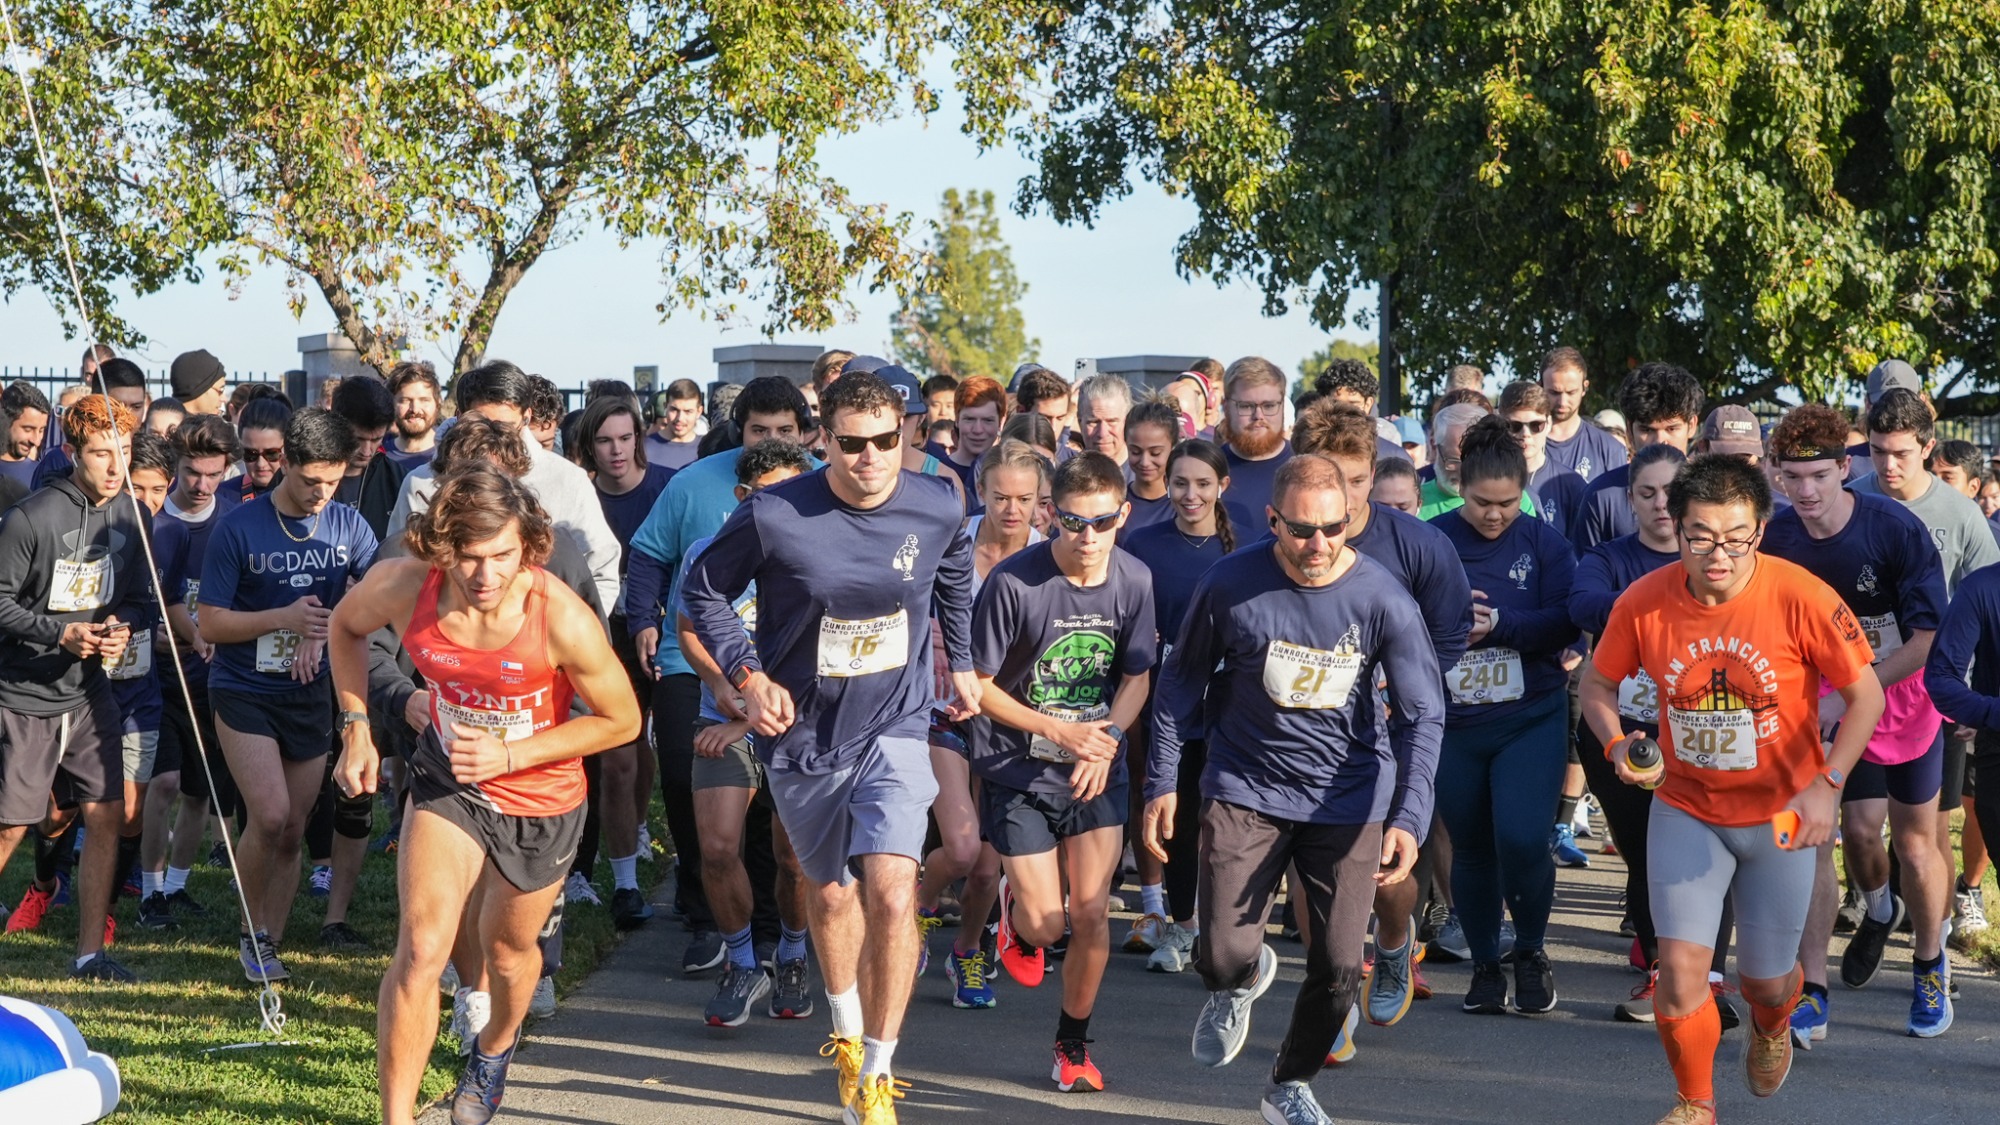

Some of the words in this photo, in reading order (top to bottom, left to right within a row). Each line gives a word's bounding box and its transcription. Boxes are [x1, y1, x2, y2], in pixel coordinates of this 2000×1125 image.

[824, 621, 870, 631] GUNROCK'S
[873, 616, 902, 628] GALLOP
[1860, 618, 1886, 626] GALLOP
[1873, 621, 1895, 629] AGGIES
[850, 634, 880, 657] 16
[431, 654, 461, 667] MEDS
[1270, 651, 1284, 660] RUN
[1273, 645, 1319, 661] GUNROCK'S
[1321, 655, 1352, 665] GALLOP
[1486, 650, 1512, 659] GALLOP
[1687, 636, 1778, 694] FRANCISCO
[1291, 665, 1327, 693] 21
[1459, 662, 1508, 691] 240
[1032, 686, 1069, 702] SAN
[437, 707, 451, 717] RUN
[453, 713, 462, 721] TO
[464, 717, 483, 725] FEED
[502, 719, 530, 727] AGGIES
[439, 701, 484, 720] GUNROCK'S
[487, 714, 521, 723] GALLOP
[1040, 707, 1080, 721] GUNROCK'S
[1082, 708, 1104, 720] GALLOP
[1669, 710, 1709, 723] GUNROCK'S
[1711, 715, 1742, 723] GALLOP
[1681, 727, 1737, 754] 202
